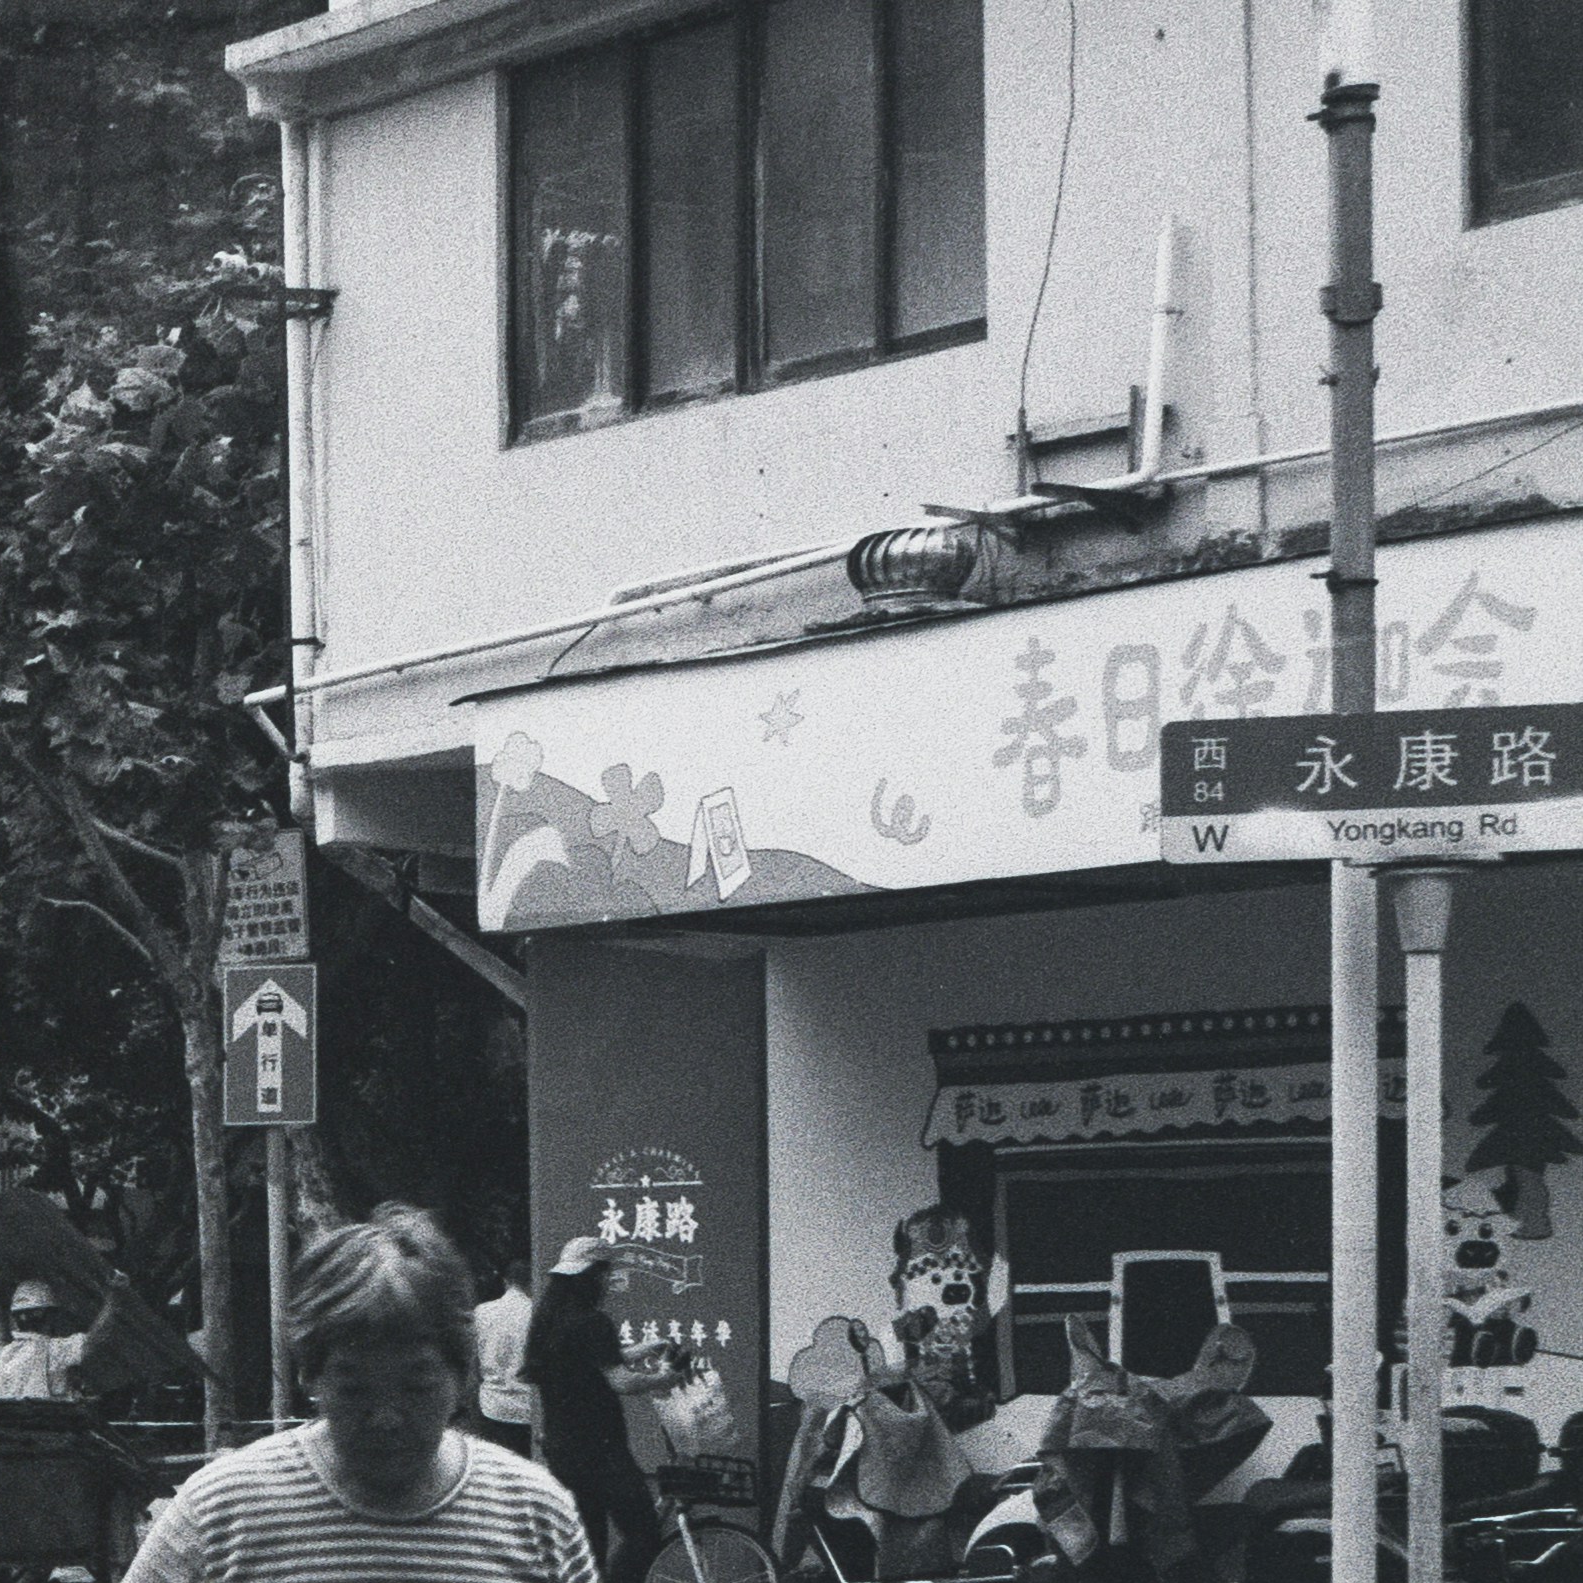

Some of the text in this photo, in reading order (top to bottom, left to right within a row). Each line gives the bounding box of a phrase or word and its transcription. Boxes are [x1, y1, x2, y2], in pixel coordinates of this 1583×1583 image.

[1191, 726, 1557, 794] 西 永康路
[1193, 780, 1226, 803] 84
[1191, 813, 1518, 853] W Yongkang Rd
[597, 1195, 700, 1246] 永康路
